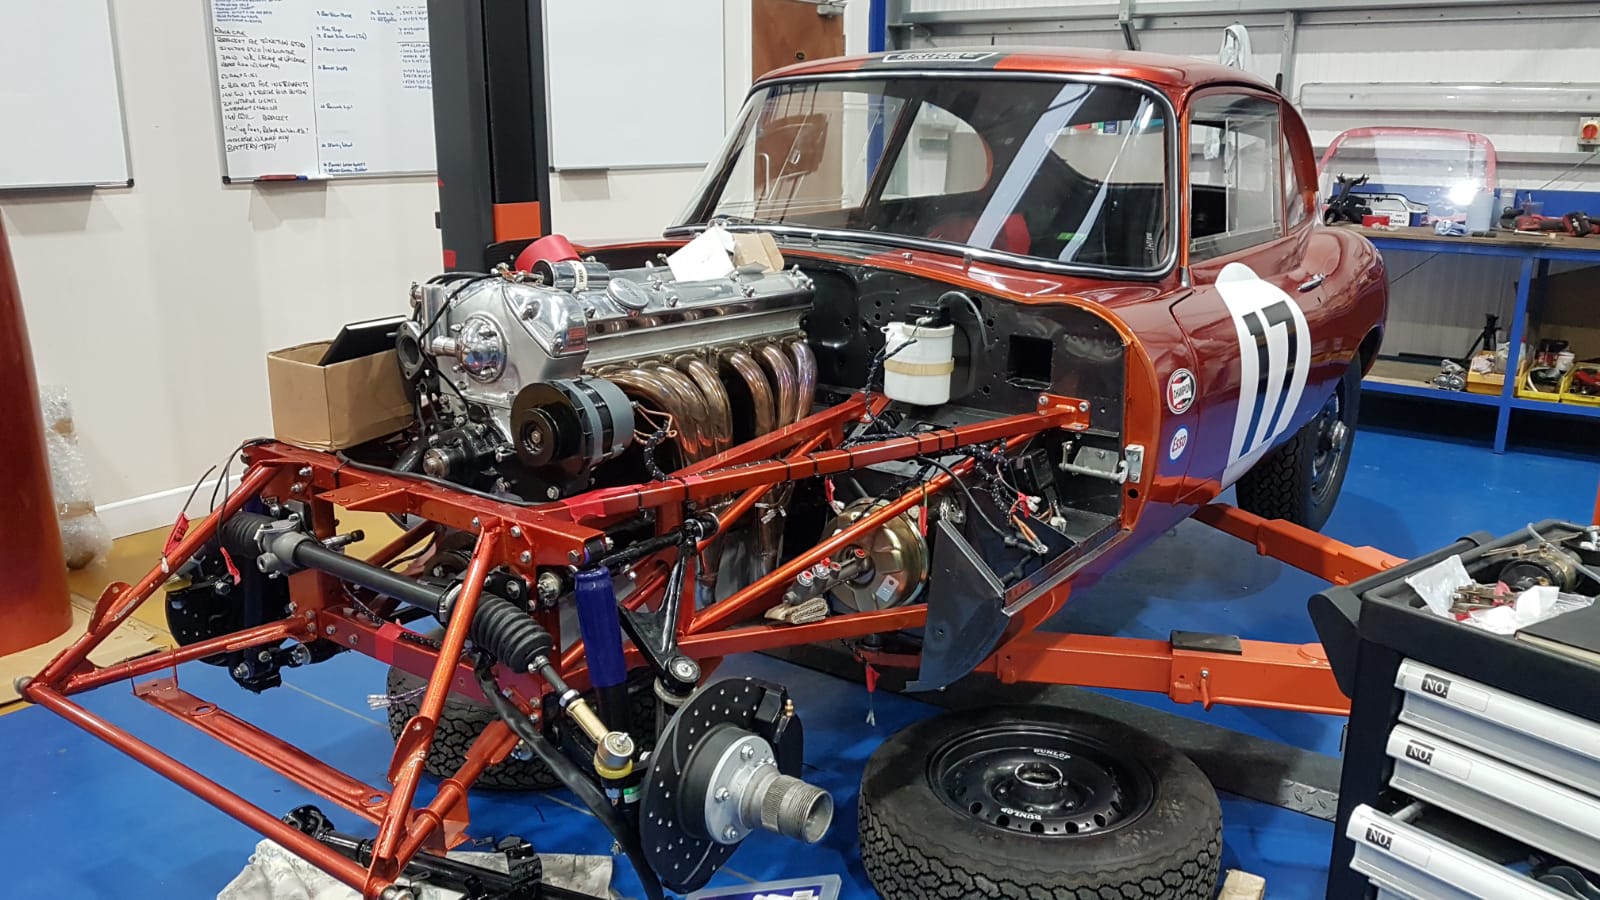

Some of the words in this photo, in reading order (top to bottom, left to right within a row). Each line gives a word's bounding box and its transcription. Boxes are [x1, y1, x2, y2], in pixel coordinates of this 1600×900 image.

[1424, 677, 1447, 697] NO.
[1033, 748, 1071, 759] DUNLOP
[1408, 747, 1431, 763] NO.
[1000, 807, 1042, 820] DUNLOP
[1369, 830, 1391, 849] NO.
